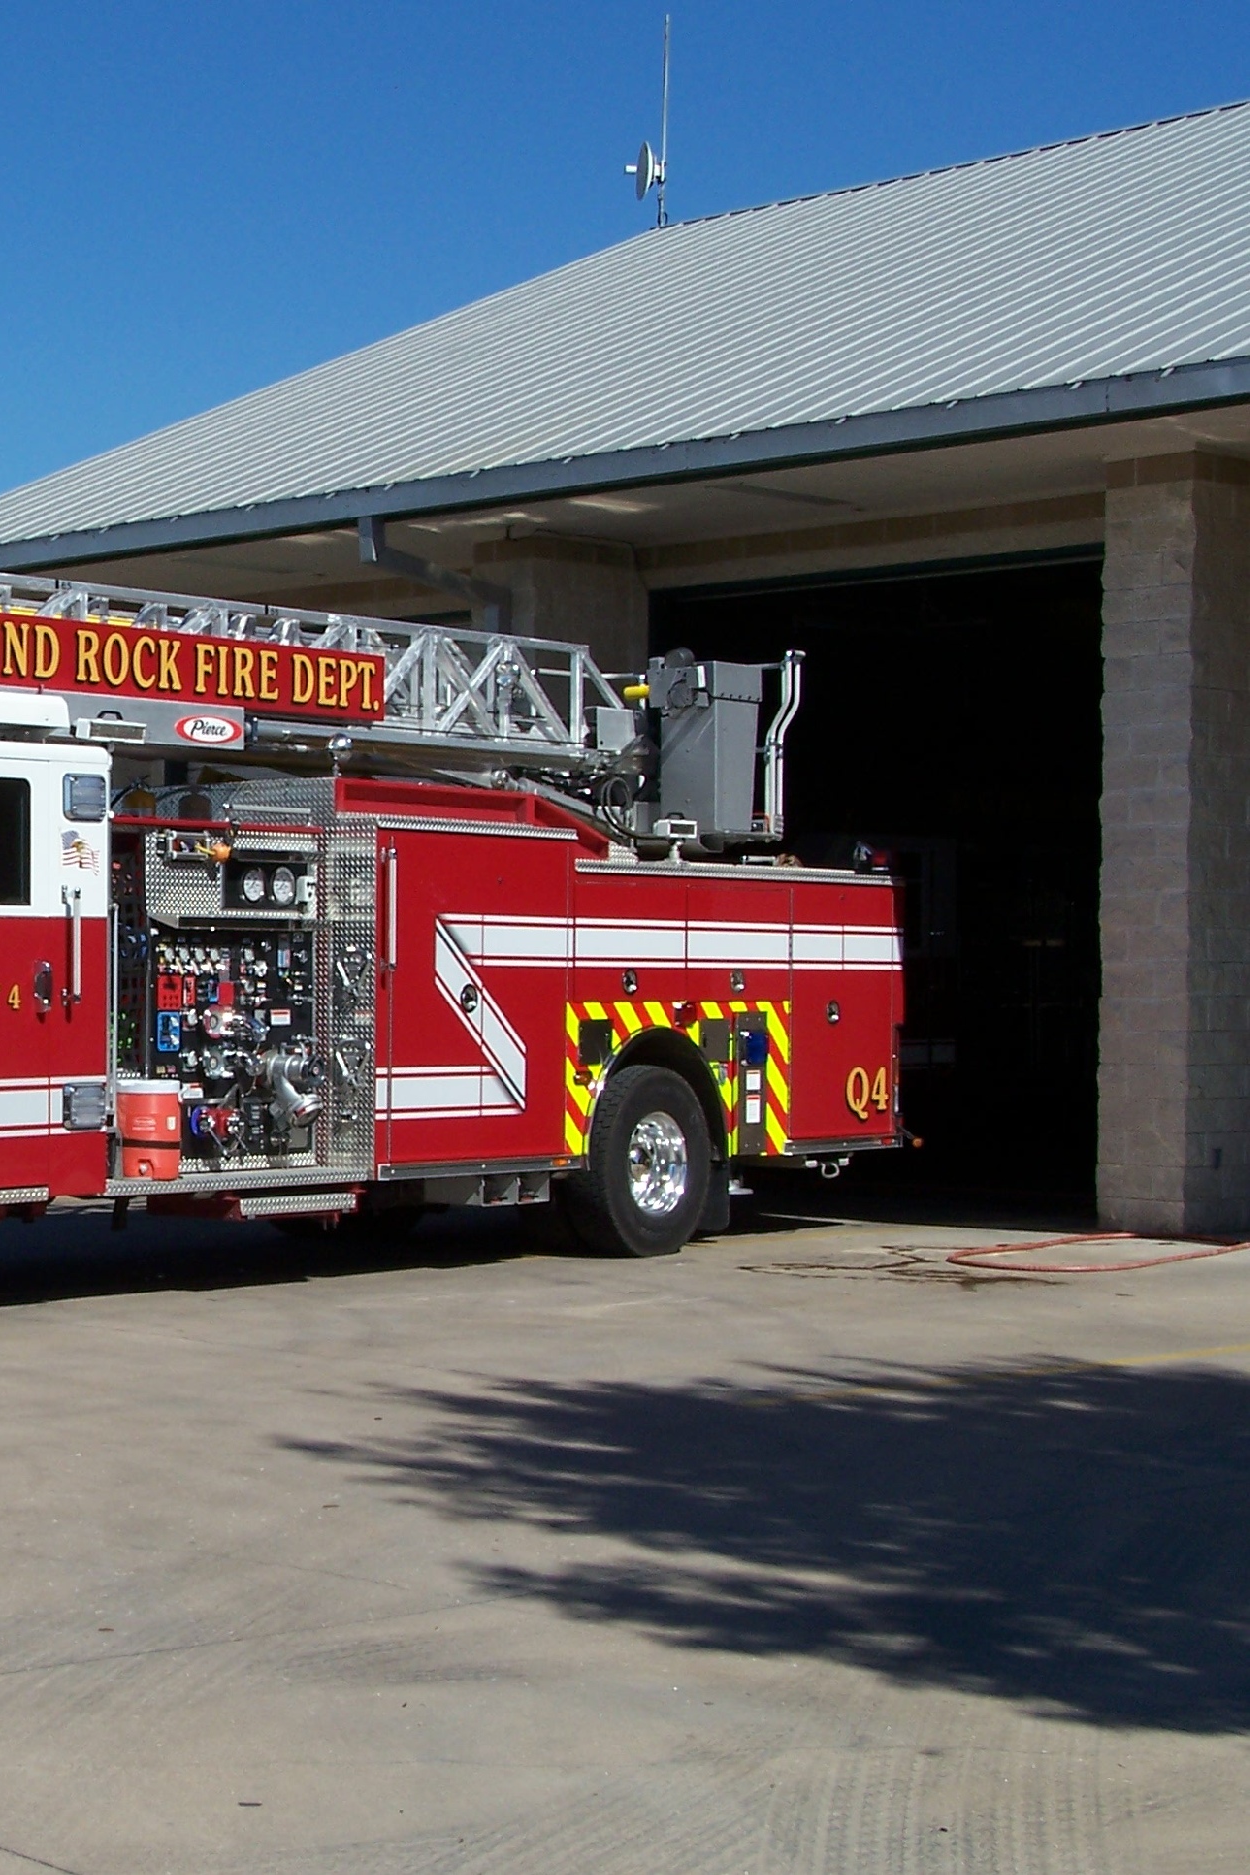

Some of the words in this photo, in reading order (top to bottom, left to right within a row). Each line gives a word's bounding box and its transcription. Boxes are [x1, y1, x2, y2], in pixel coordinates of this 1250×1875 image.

[76, 629, 182, 691] ROCK
[195, 643, 279, 701] FIRE
[292, 653, 380, 712] DEPT.
[190, 719, 228, 737] Pierce
[8, 984, 21, 1010] 4
[845, 1066, 890, 1120] Q4
